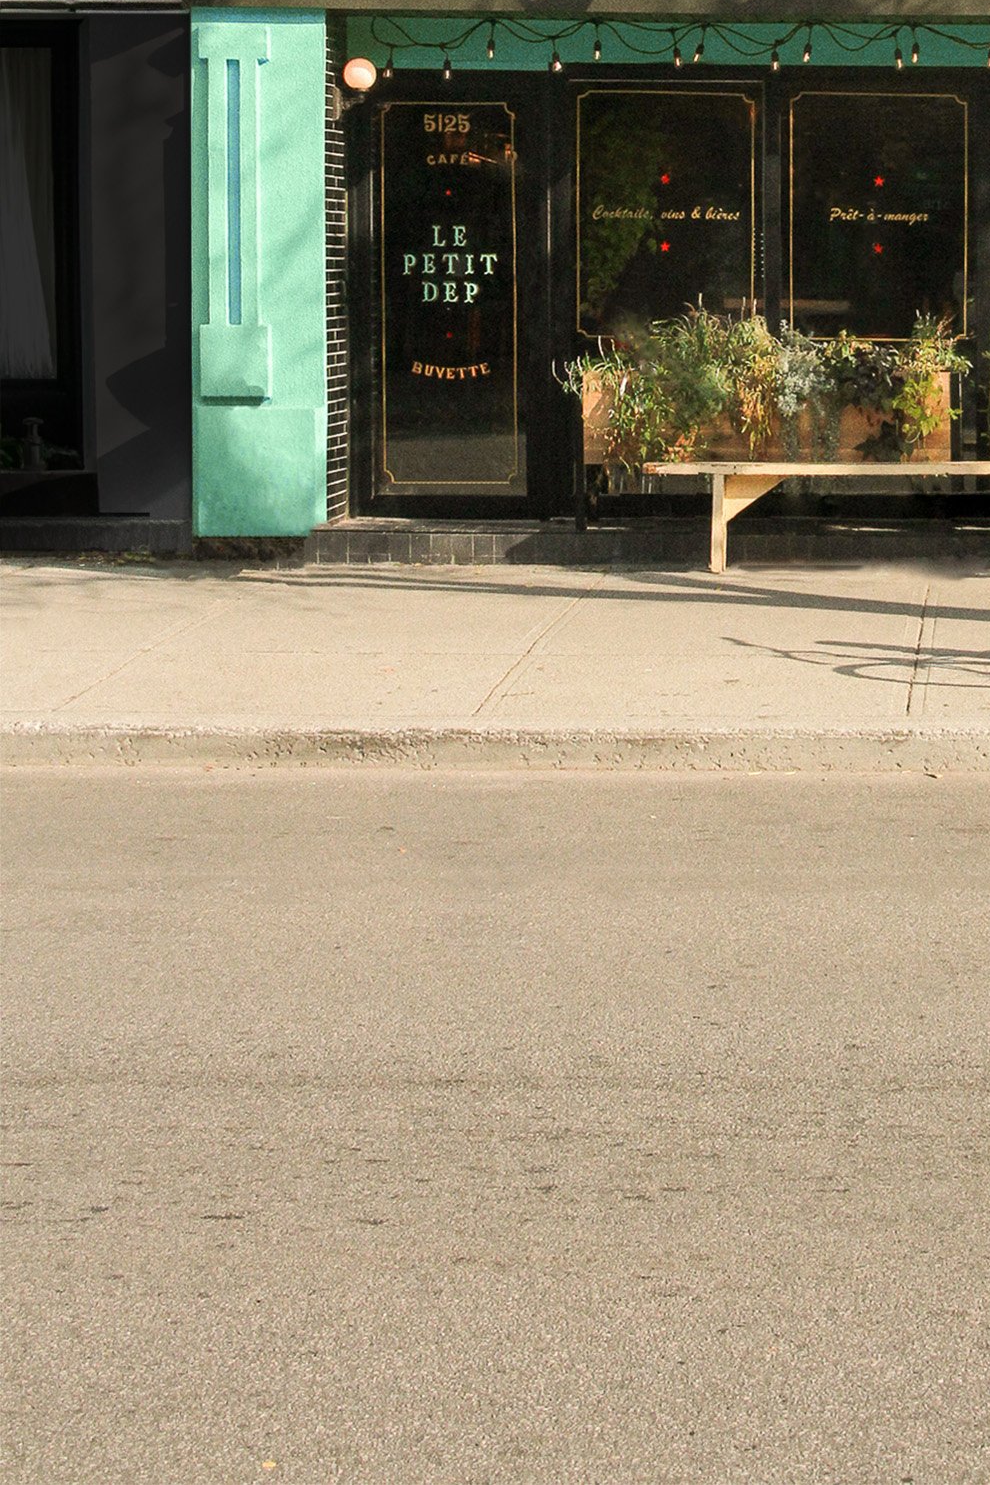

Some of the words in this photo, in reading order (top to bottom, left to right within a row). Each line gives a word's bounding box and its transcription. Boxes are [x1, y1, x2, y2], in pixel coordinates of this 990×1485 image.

[423, 114, 471, 133] 5125
[660, 209, 685, 220] vins
[690, 206, 701, 220] &
[705, 206, 741, 221] bières
[431, 225, 468, 247] LE
[402, 253, 498, 276] PETIT
[421, 281, 480, 304] DEP
[411, 362, 491, 380] BUVETTE
